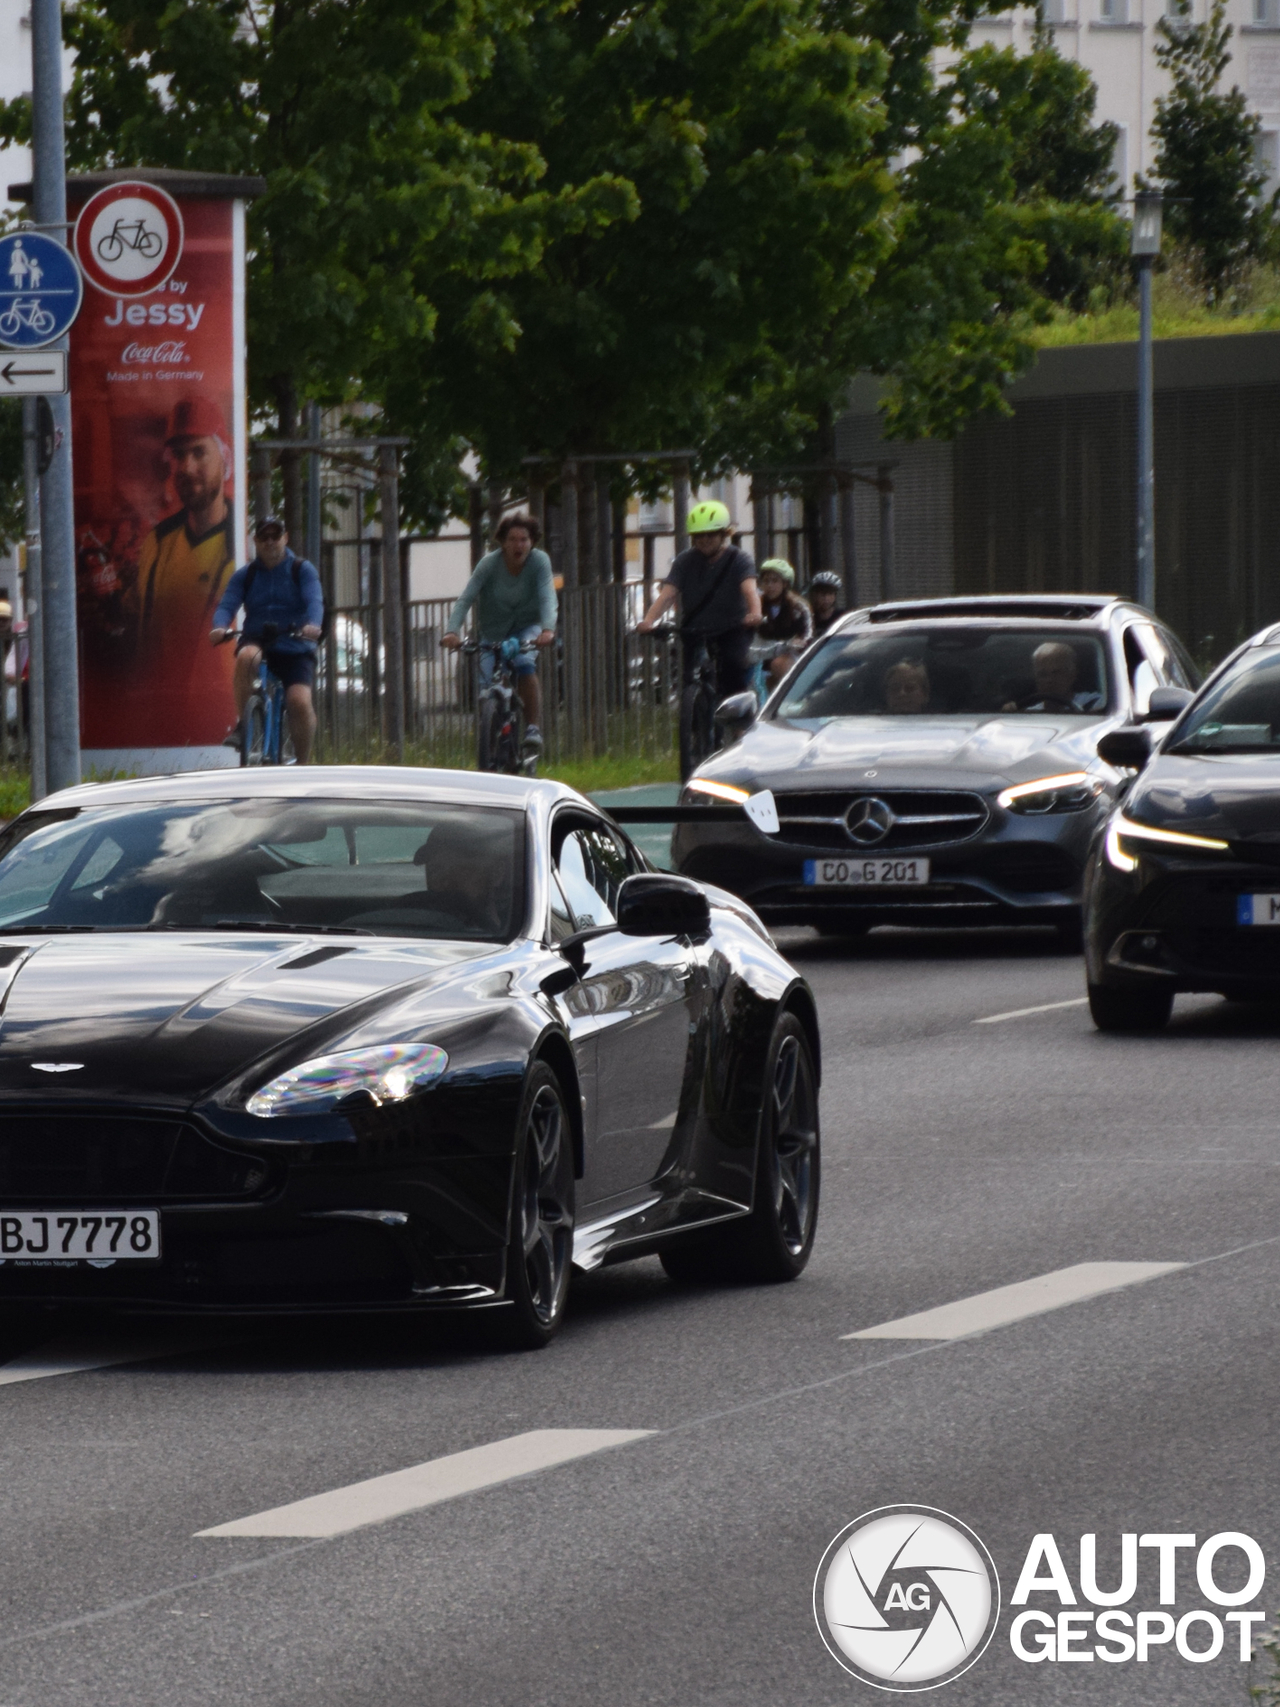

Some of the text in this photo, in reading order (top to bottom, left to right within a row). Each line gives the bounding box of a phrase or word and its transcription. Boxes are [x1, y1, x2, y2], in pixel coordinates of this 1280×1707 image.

[170, 279, 188, 294] by
[104, 300, 205, 330] Jessy
[107, 370, 204, 381] Made in Germany
[823, 862, 849, 882] CO
[881, 862, 919, 881] 201
